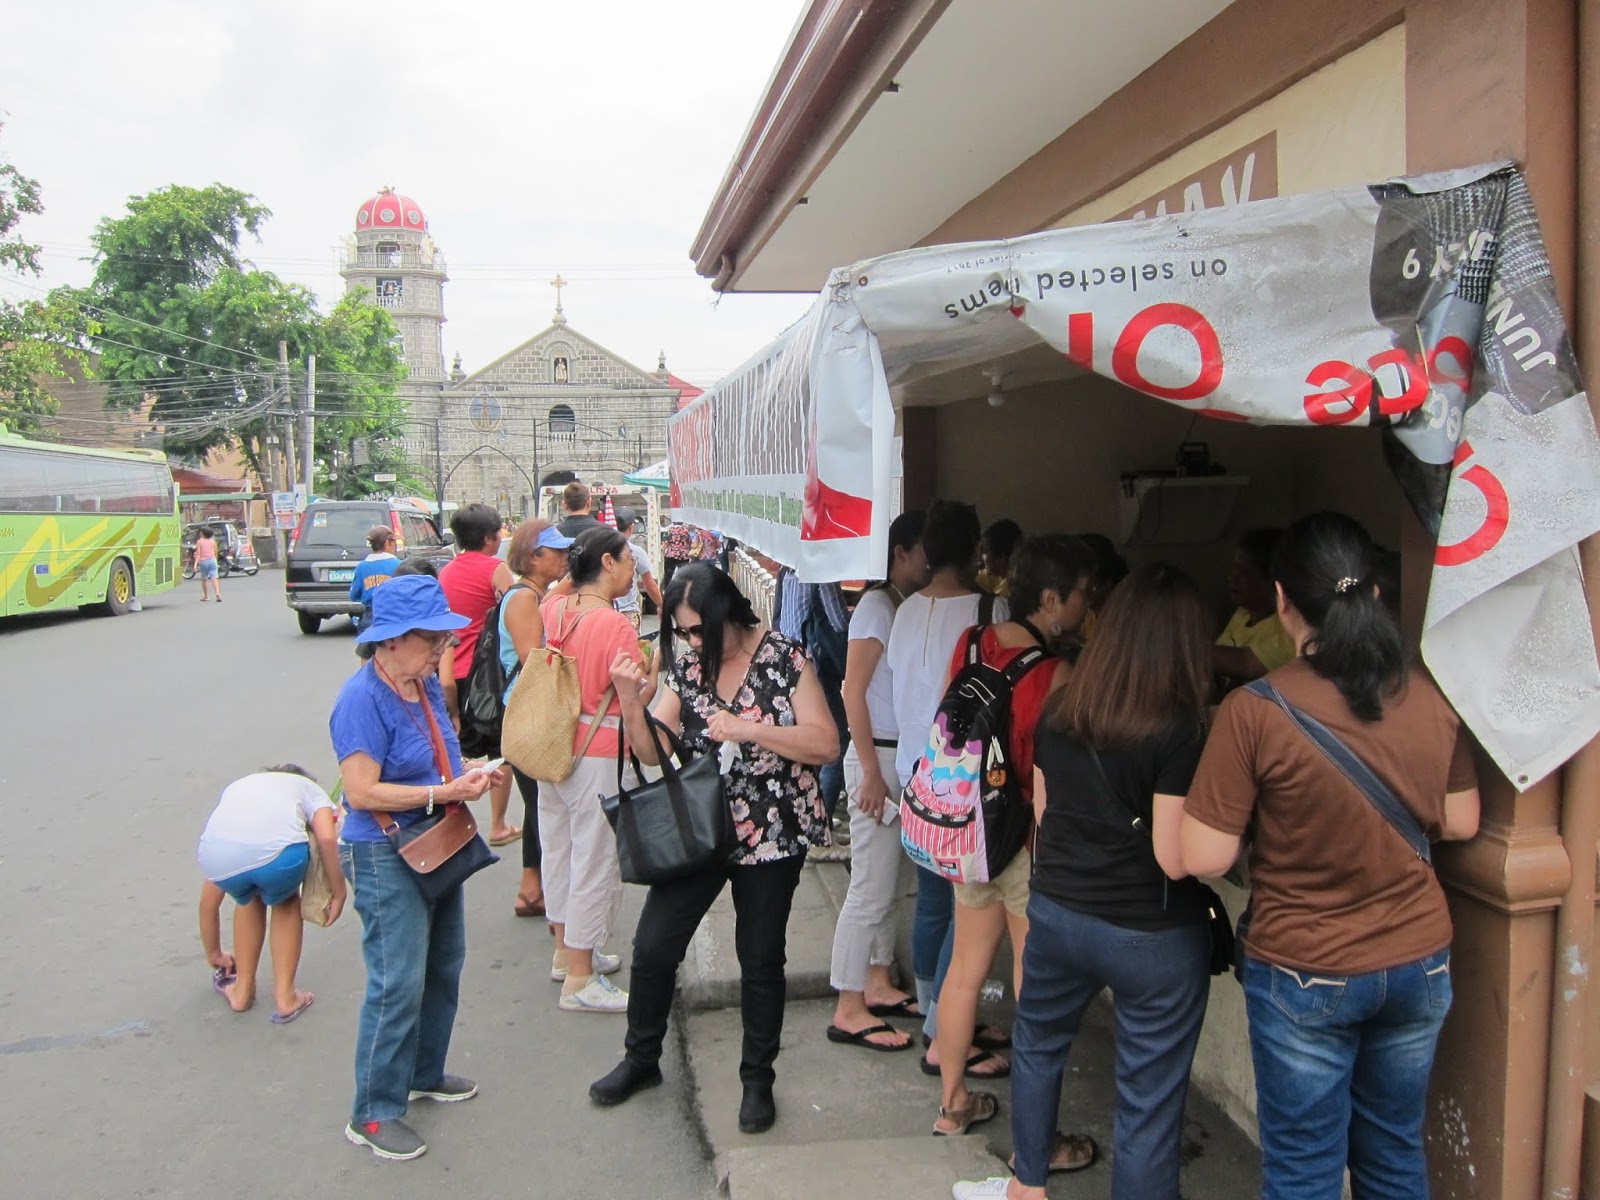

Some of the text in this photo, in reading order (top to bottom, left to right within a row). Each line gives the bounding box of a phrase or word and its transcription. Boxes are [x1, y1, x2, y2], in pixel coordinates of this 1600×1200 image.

[975, 258, 985, 267] of
[1191, 259, 1228, 280] on
[1403, 248, 1420, 279] 9
[1037, 263, 1174, 299] selected
[589, 486, 619, 494] LISYA
